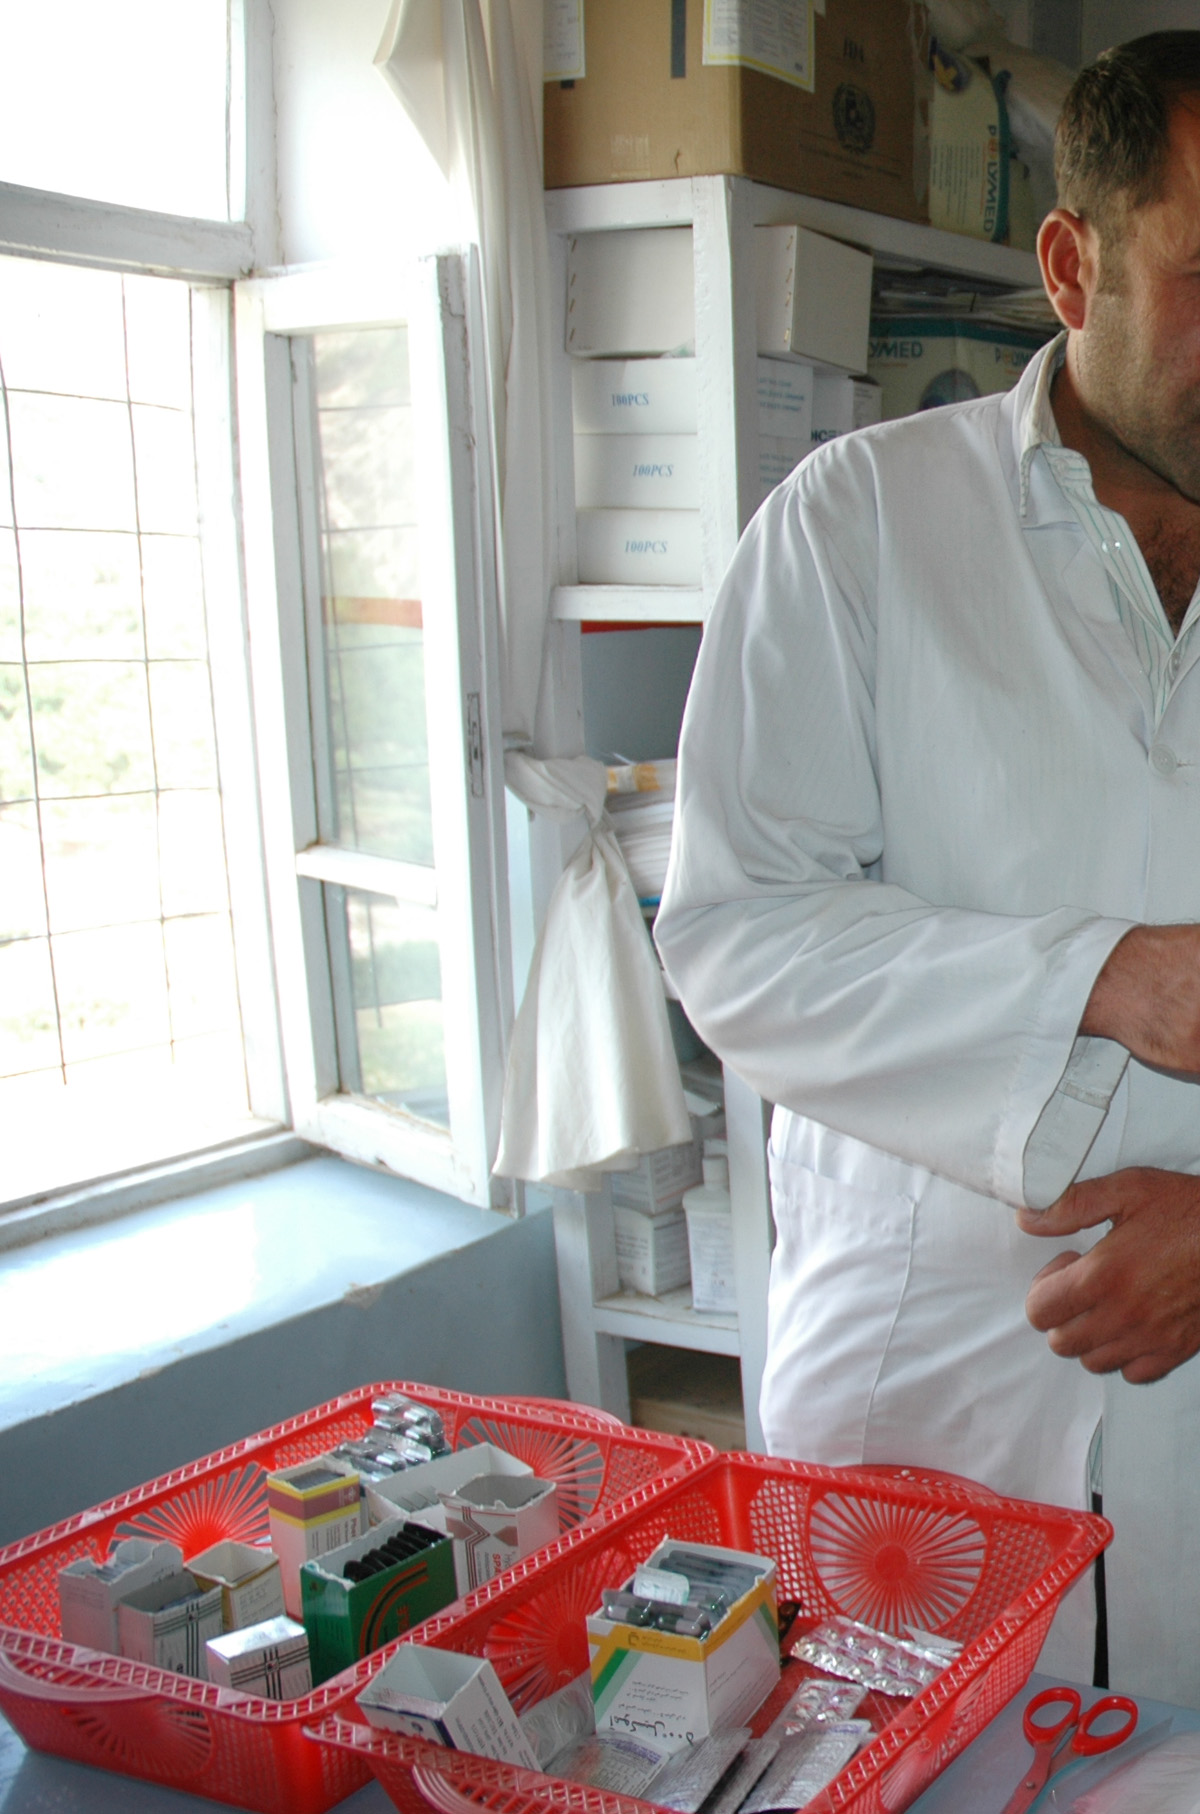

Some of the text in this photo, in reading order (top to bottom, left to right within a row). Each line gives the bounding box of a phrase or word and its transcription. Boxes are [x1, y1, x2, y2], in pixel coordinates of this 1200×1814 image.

[982, 124, 998, 233] POLYMED
[611, 393, 650, 407] 100PCS
[632, 464, 674, 478] 100PCS
[624, 540, 669, 553] 100PCS
